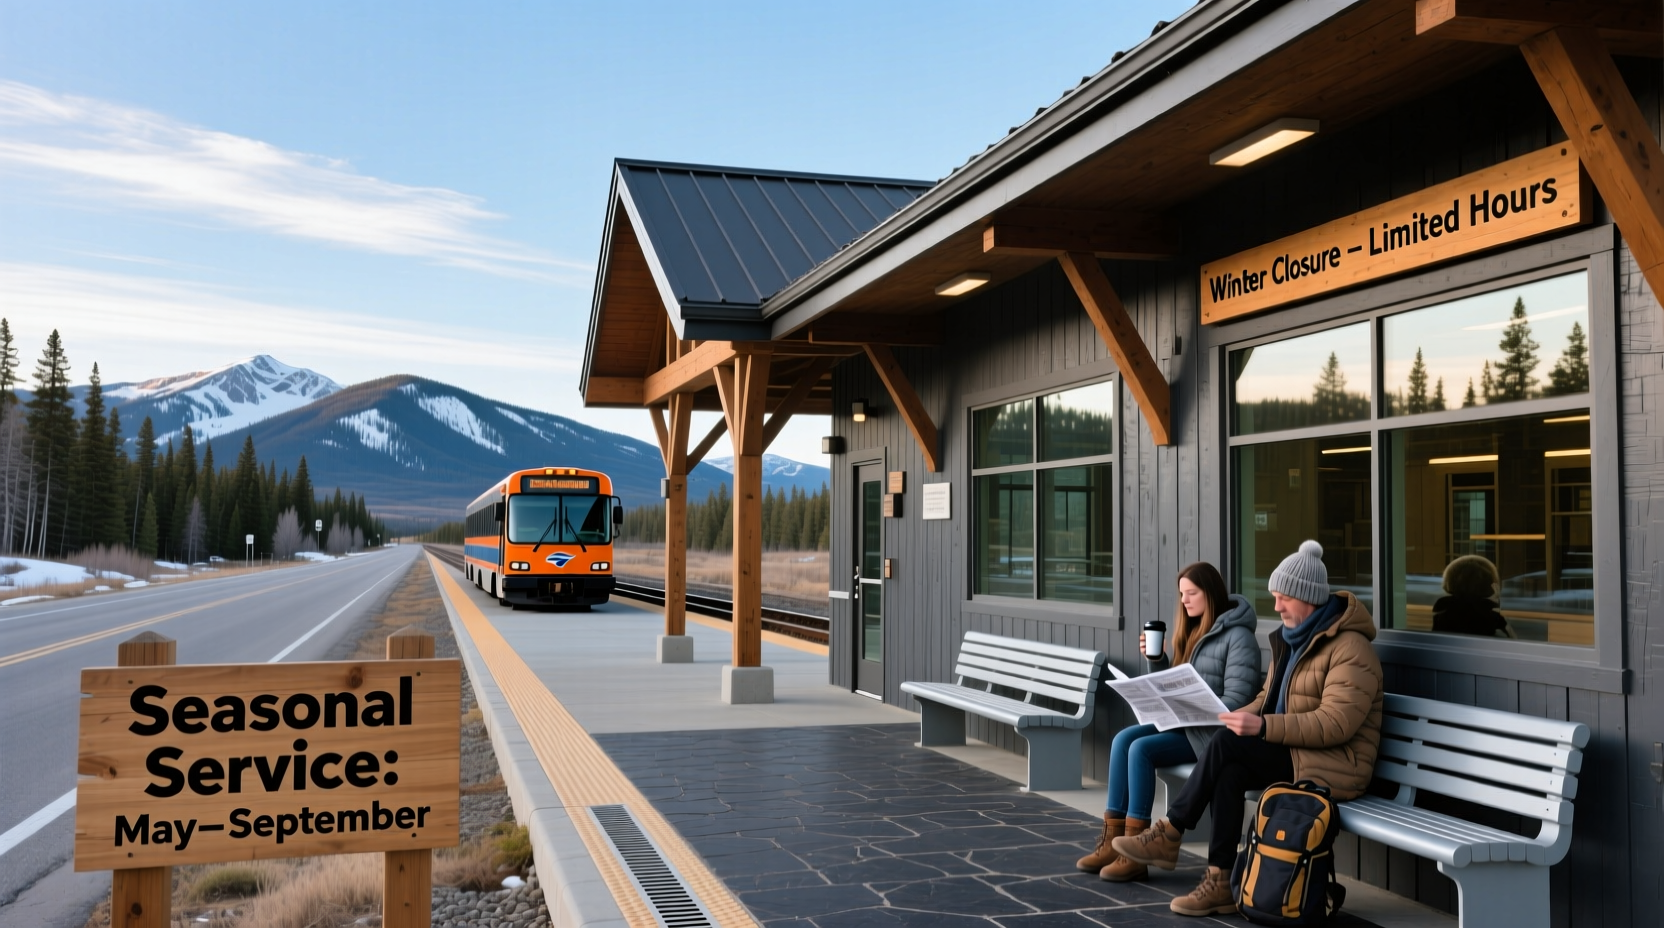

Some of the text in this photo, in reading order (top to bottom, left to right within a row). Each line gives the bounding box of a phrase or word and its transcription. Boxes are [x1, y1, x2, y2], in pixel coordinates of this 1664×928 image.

[1209, 267, 1267, 303] Winter
[1271, 246, 1341, 285] Closure
[1369, 199, 1460, 257] Limited
[1470, 177, 1557, 227] Hours
[128, 676, 413, 736] Seasonal
[144, 738, 398, 798] Service:
